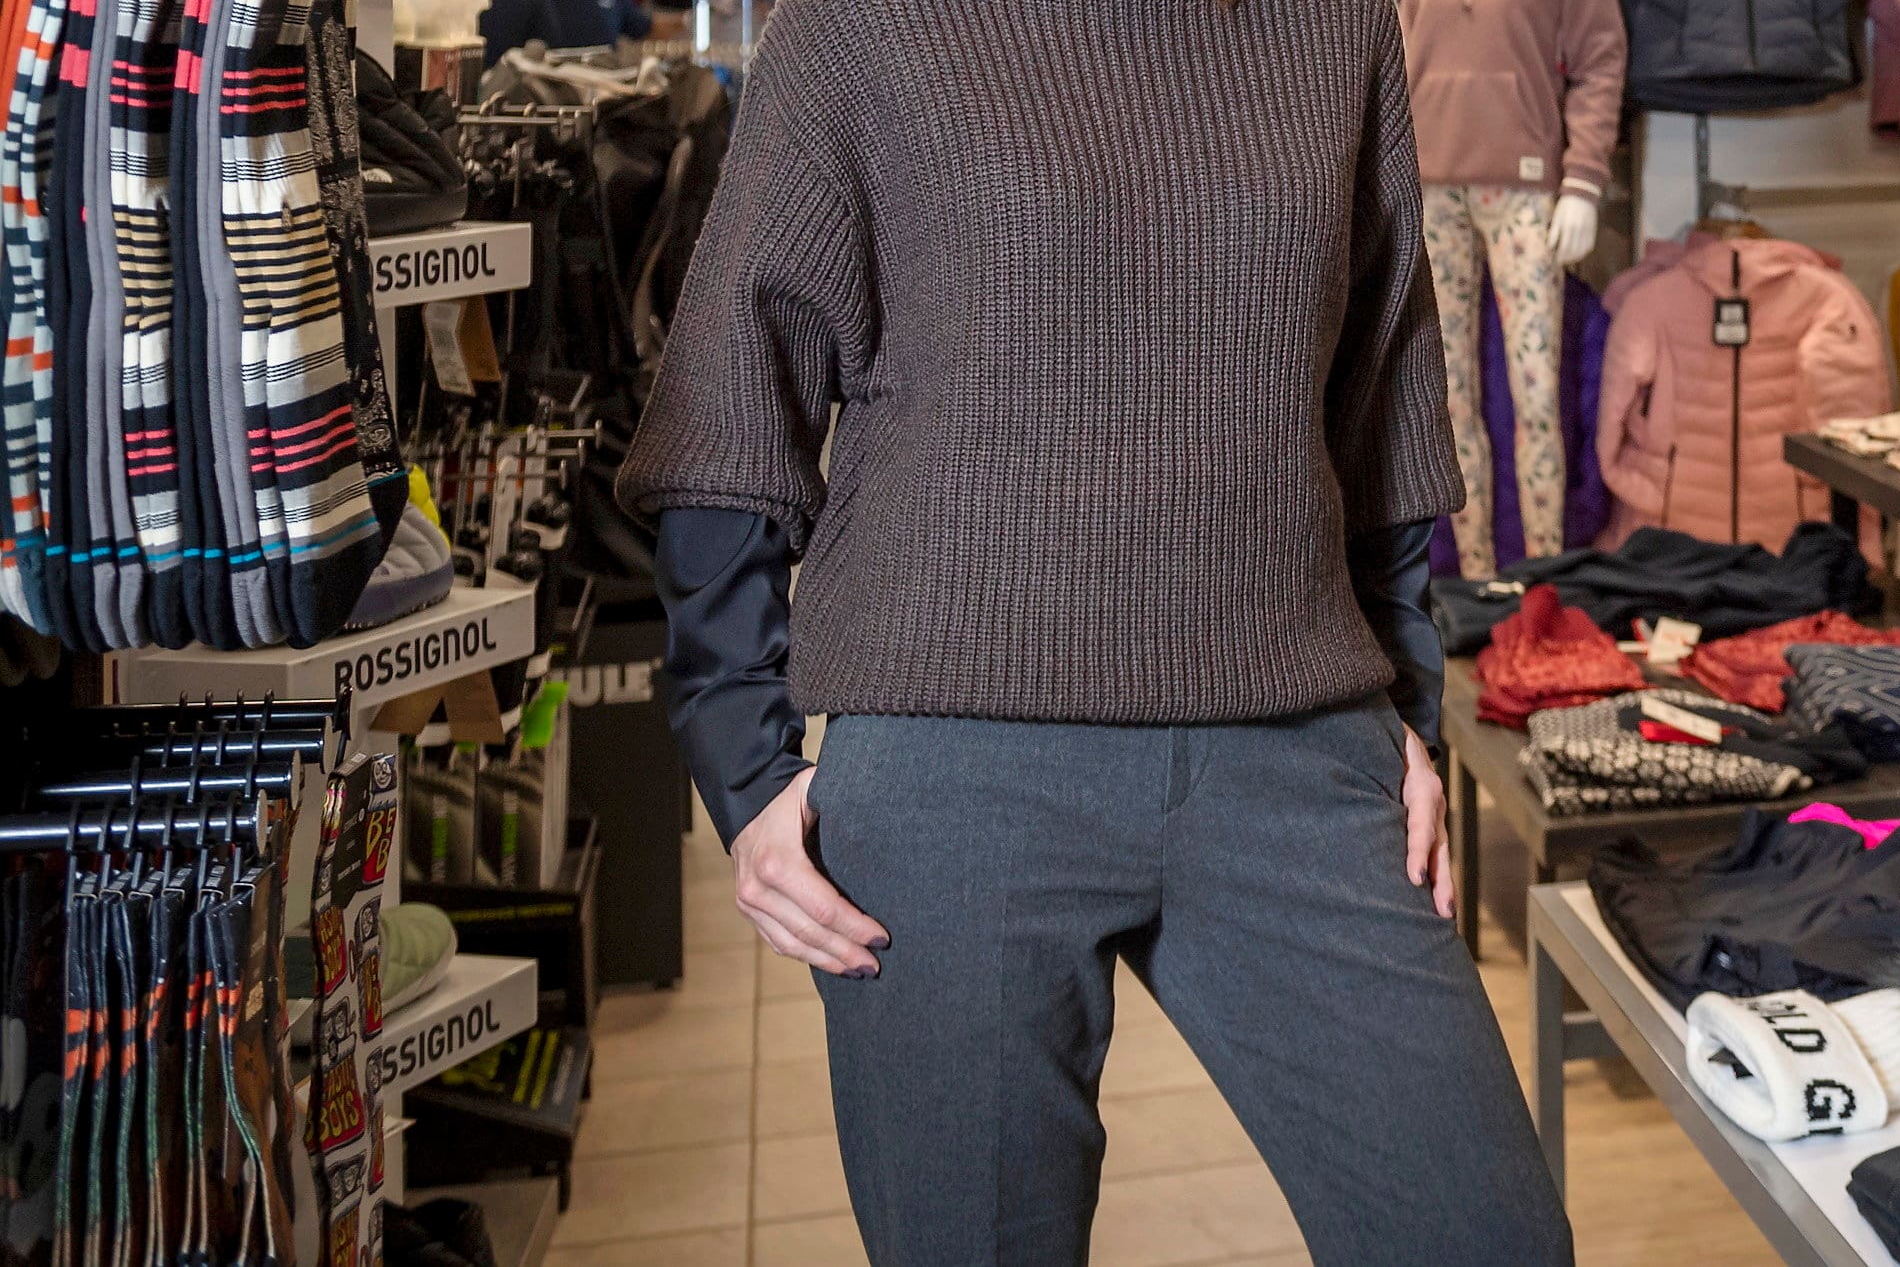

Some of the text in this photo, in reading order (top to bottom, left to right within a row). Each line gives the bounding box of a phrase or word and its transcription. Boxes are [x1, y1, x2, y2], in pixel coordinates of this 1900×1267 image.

[373, 242, 496, 292] SSIGNOL
[335, 618, 497, 699] ROSSIGNOL
[552, 662, 653, 707] ULE
[382, 999, 499, 1085] SSIGNOL
